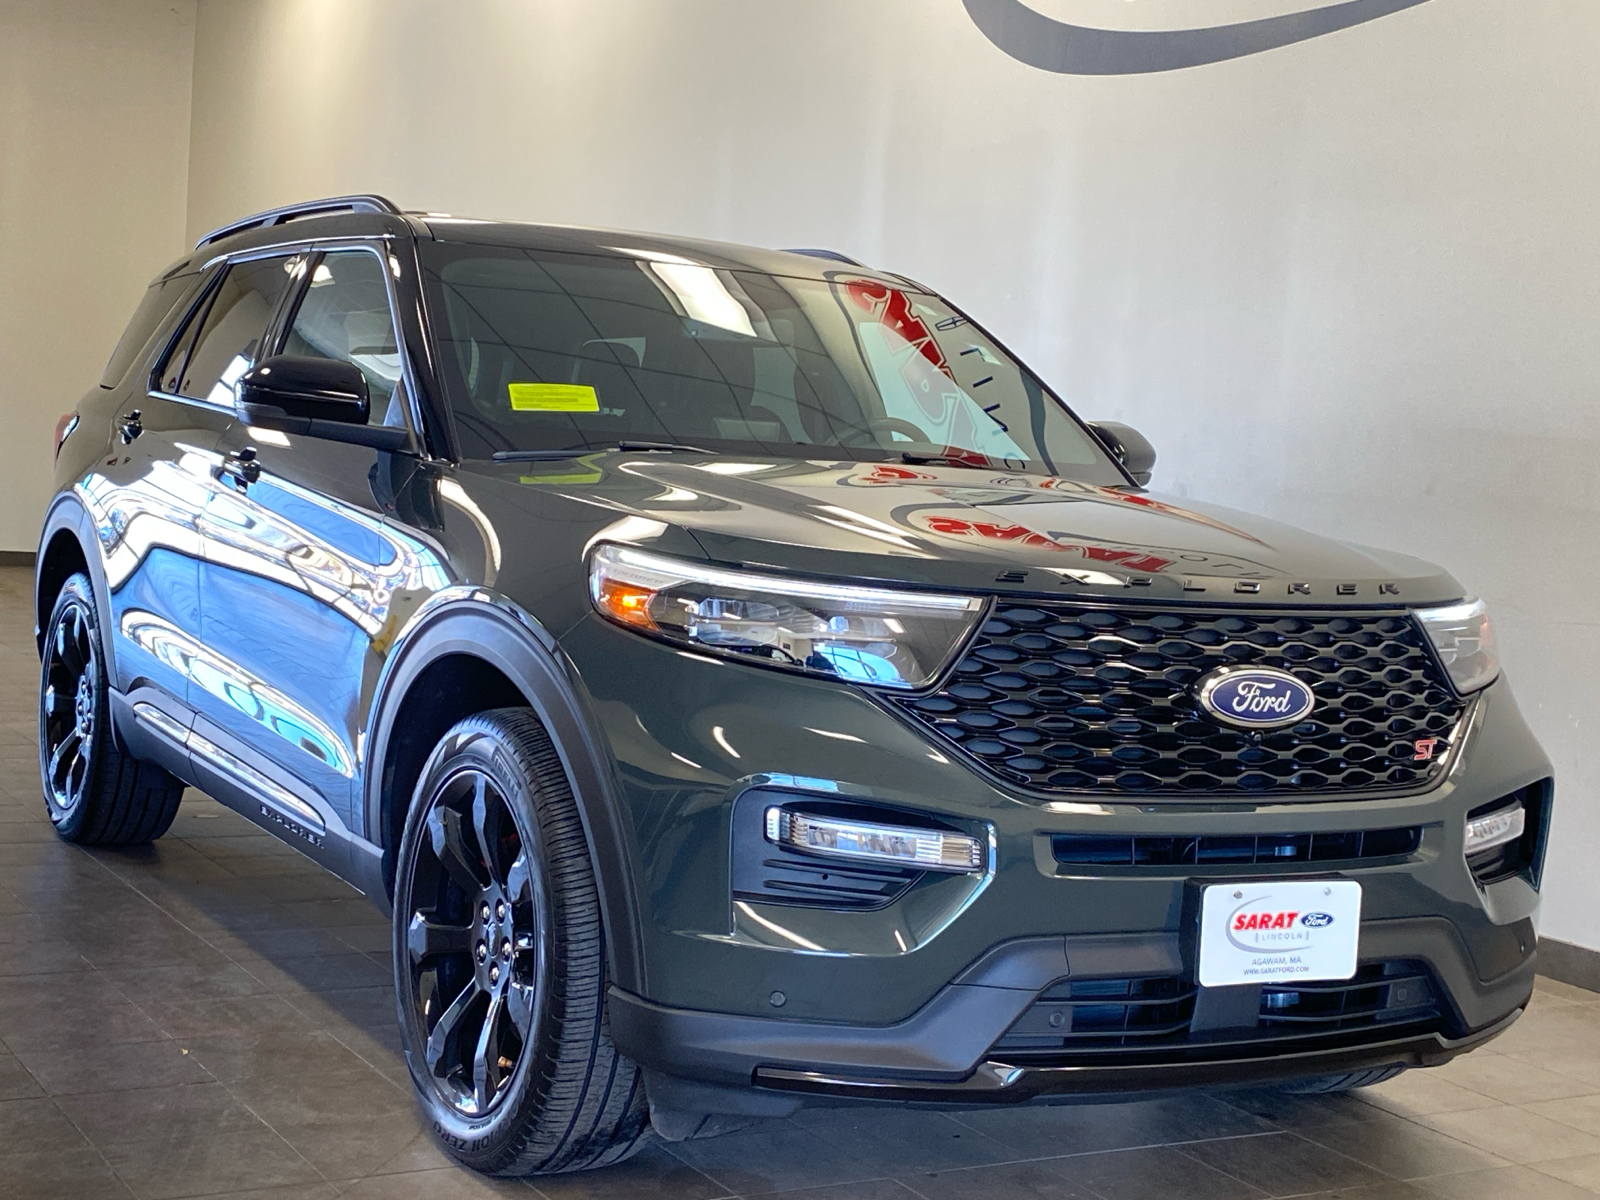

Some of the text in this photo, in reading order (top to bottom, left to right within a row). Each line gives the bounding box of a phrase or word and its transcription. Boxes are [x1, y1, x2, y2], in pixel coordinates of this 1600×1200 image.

[995, 569, 1401, 596] EXPLORER
[1232, 680, 1292, 713] Ford
[1414, 739, 1438, 761] ST
[1232, 911, 1329, 931] SARAT Ford
[1261, 932, 1303, 941] LINCOLN
[1243, 966, 1310, 976] WWW.SARATFORD.COM
[1251, 956, 1302, 967] AGAWAM, MA
